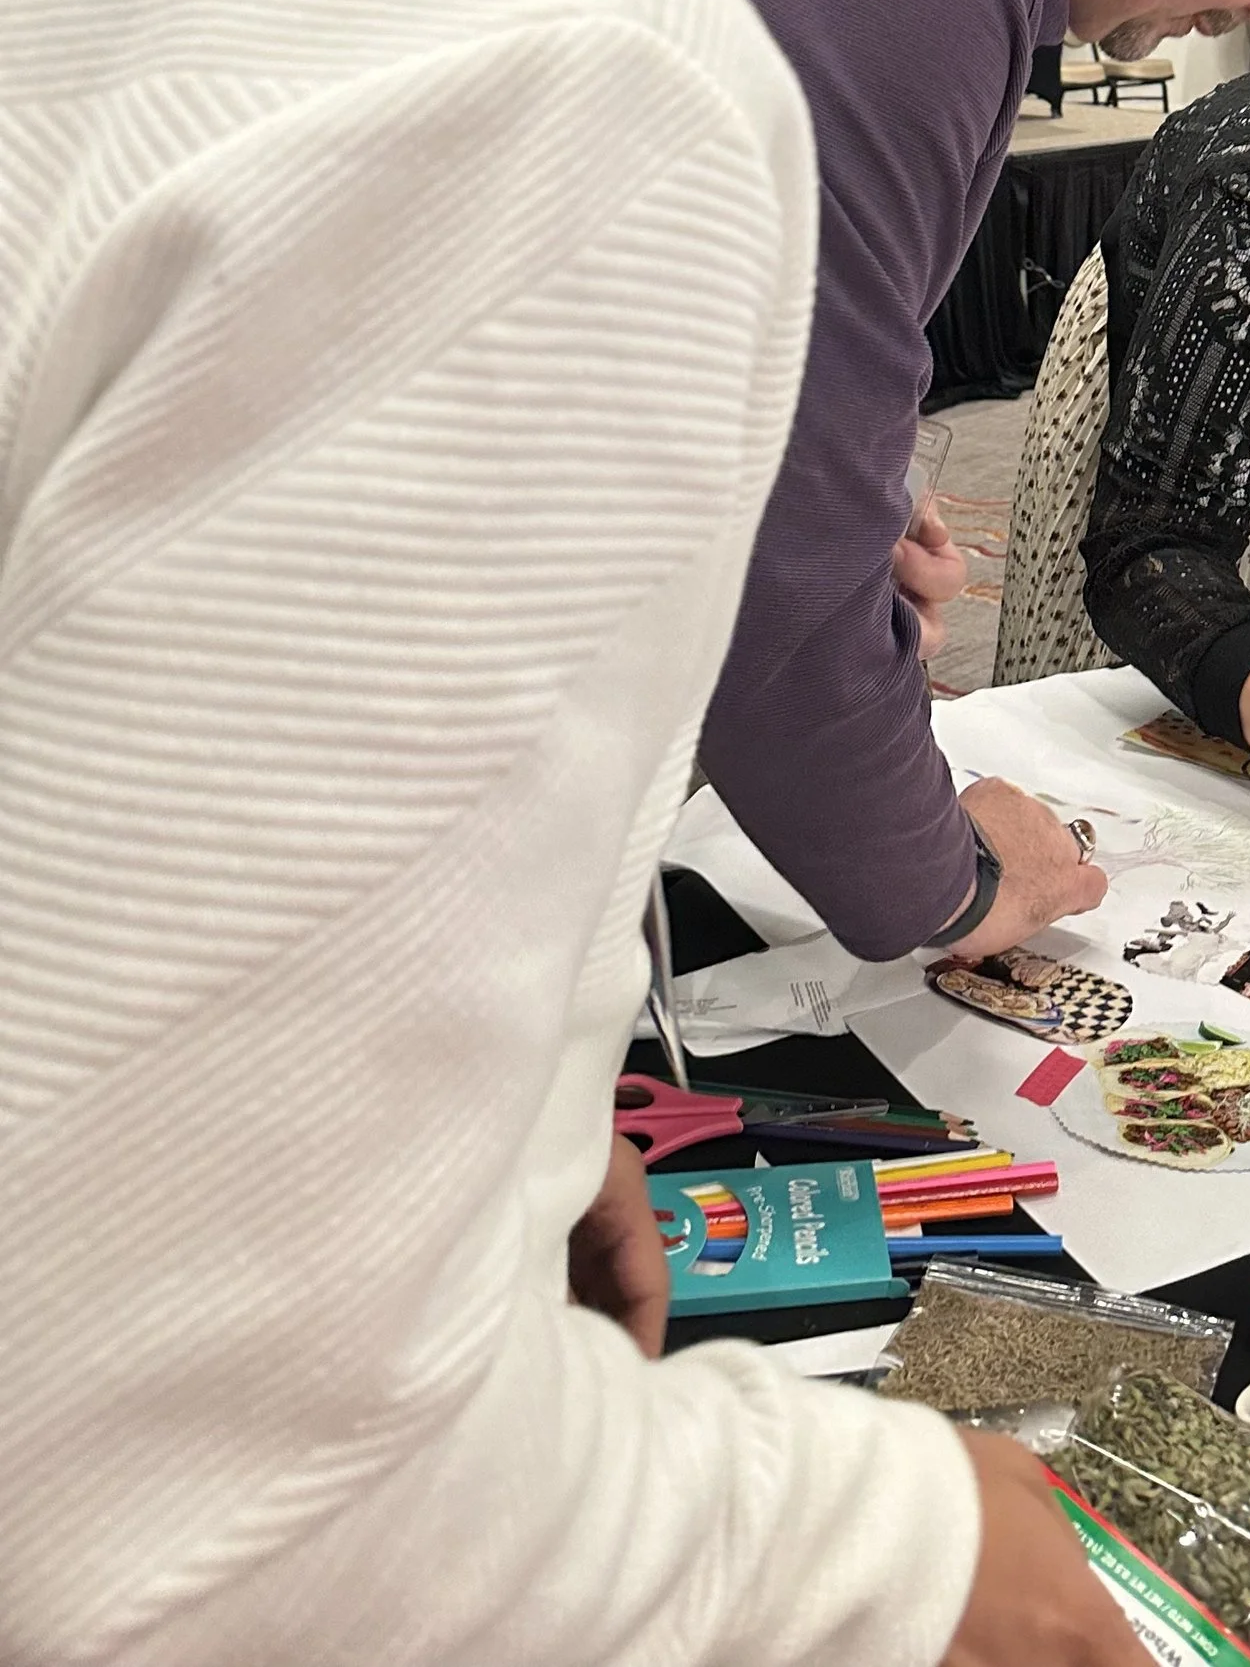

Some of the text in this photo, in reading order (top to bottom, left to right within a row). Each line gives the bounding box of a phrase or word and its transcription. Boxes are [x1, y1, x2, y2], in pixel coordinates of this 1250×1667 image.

[746, 1185, 776, 1262] Pre-Sharpened
[788, 1178, 830, 1265] Colored Pencils
